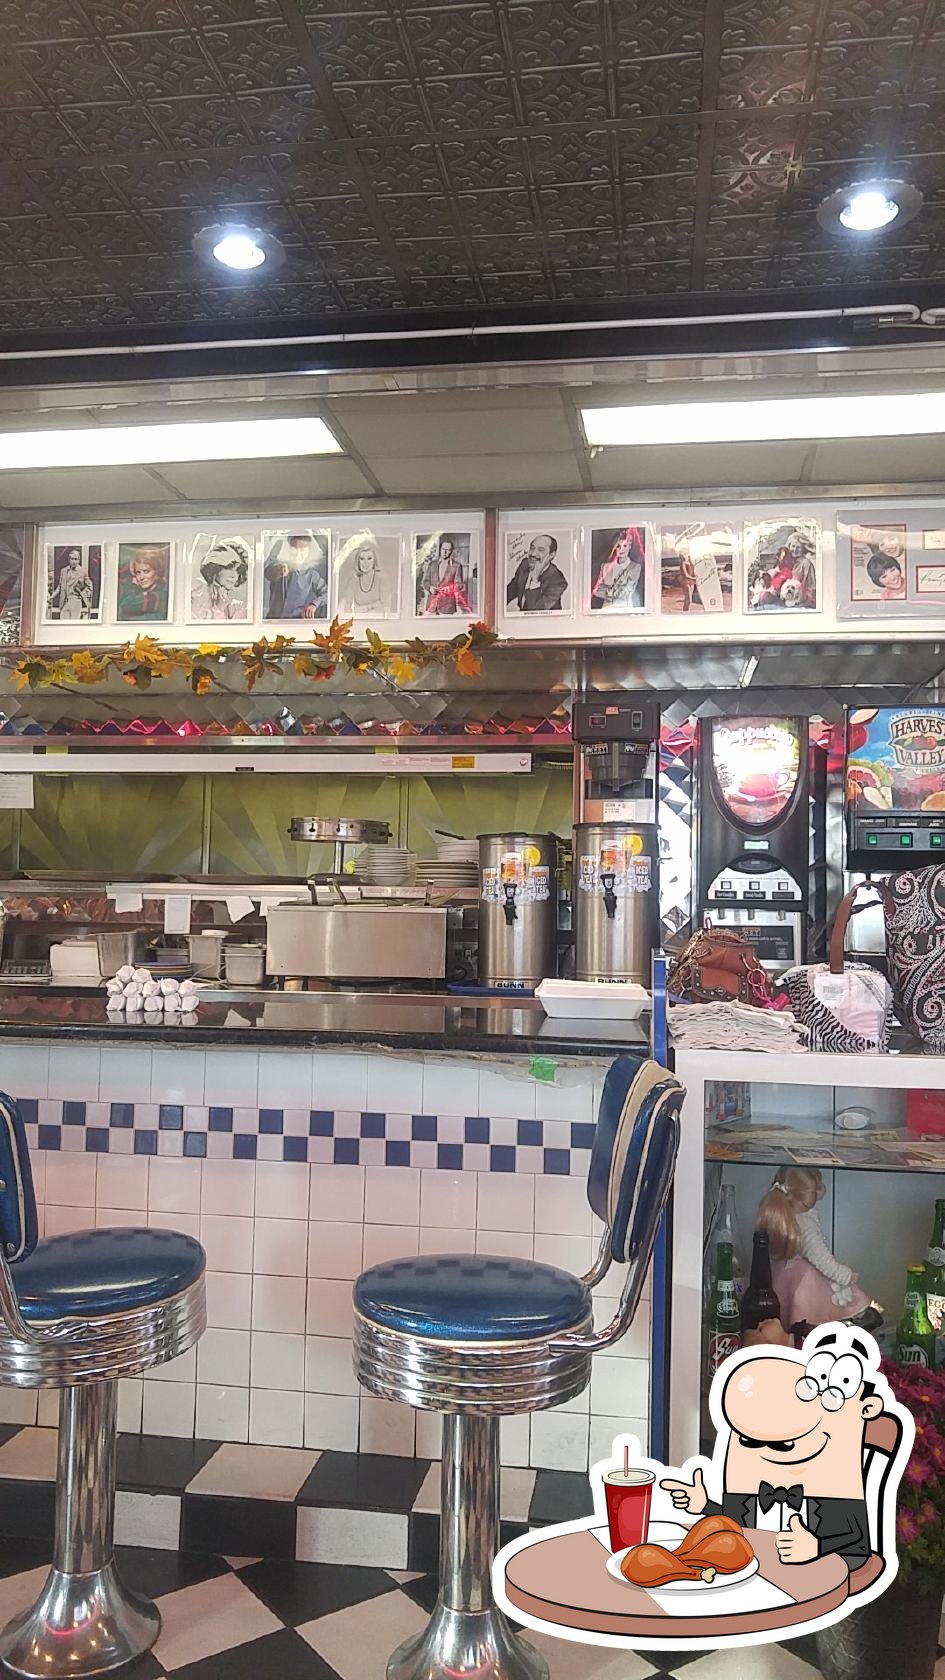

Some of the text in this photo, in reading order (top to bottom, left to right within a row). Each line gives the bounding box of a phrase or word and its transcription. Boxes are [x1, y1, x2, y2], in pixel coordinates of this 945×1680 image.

[720, 726, 794, 747] Cappuccino
[900, 748, 944, 766] VALLEY
[635, 865, 649, 874] ICED
[636, 875, 649, 885] TEA
[535, 885, 547, 894] TEA
[898, 1345, 921, 1362] Sun
